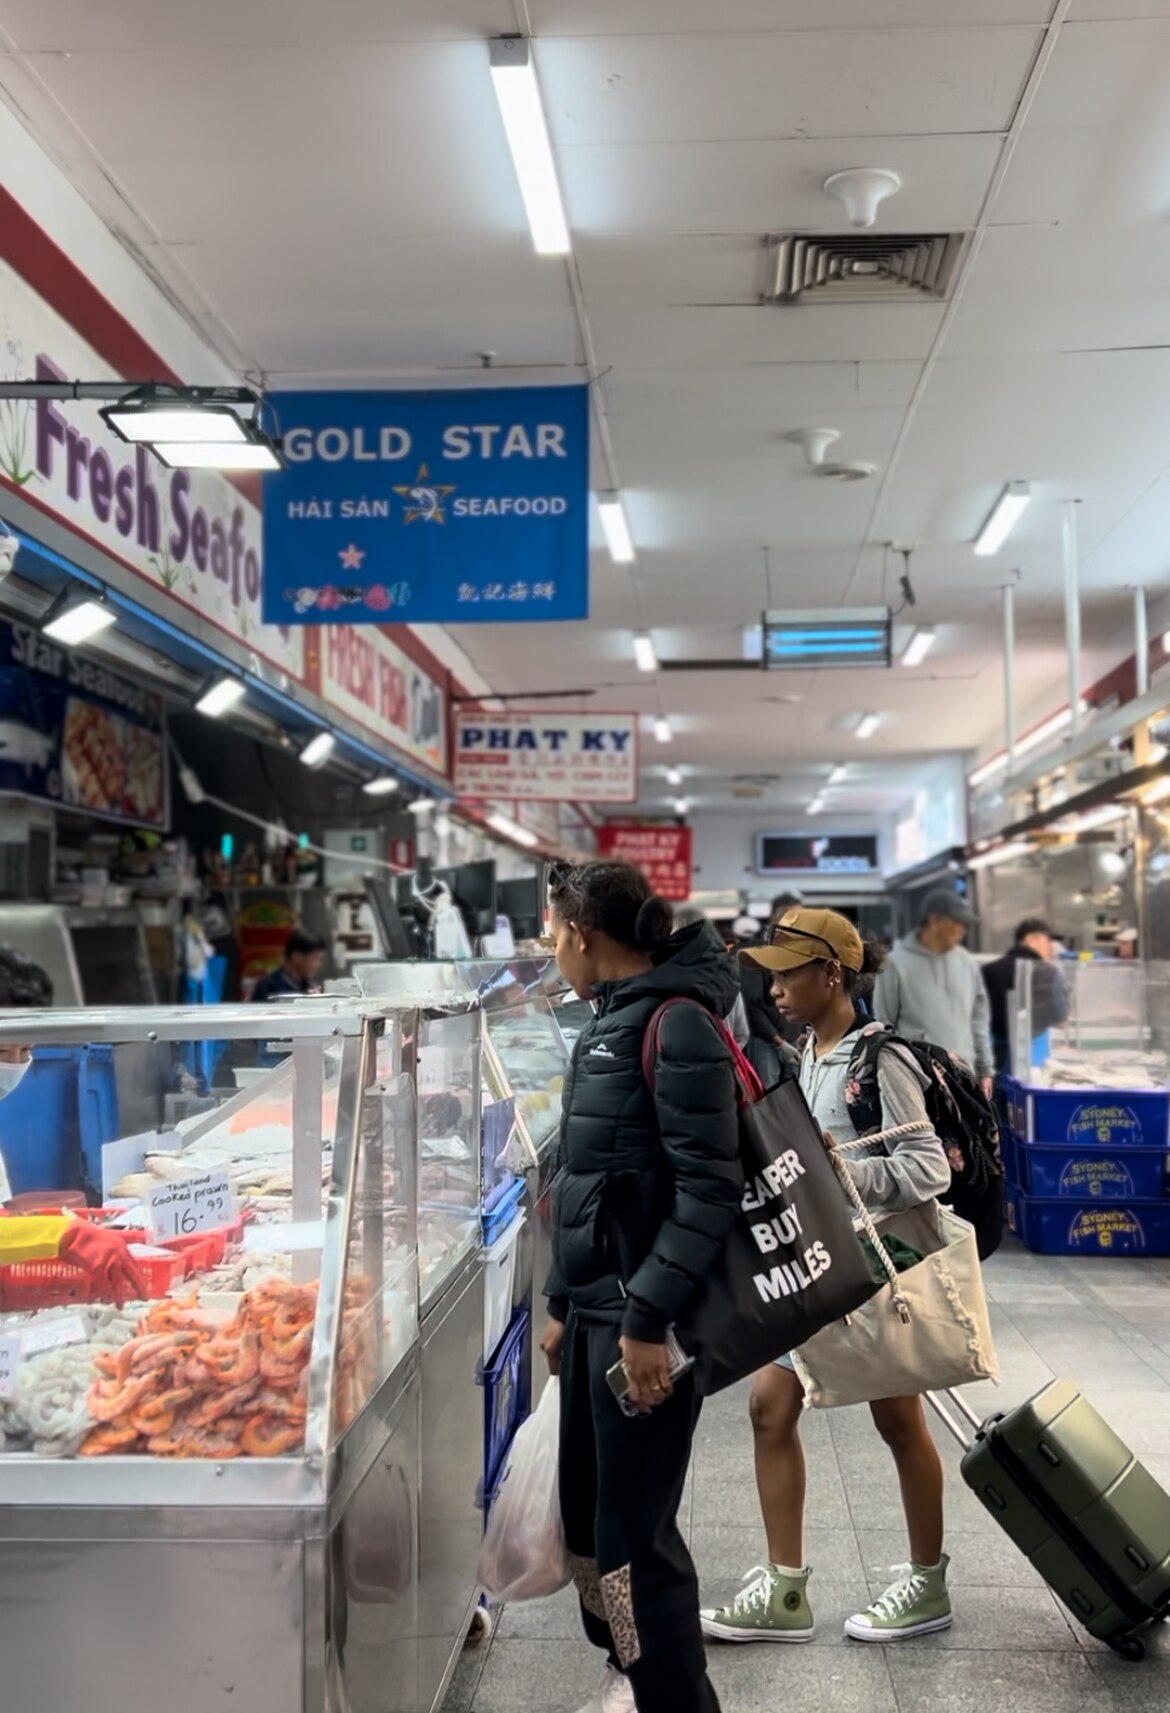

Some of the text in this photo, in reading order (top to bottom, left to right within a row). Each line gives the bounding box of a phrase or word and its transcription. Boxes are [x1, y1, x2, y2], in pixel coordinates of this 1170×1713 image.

[283, 424, 567, 462] GOLD STAR
[35, 352, 161, 554] Fresh
[453, 497, 567, 516] SEAFOOD
[11, 622, 63, 677] Star
[461, 729, 631, 750] PHAT KY
[1081, 1109, 1124, 1120] SYDNEY
[1071, 1119, 1137, 1132] FISH MARKET
[1072, 1163, 1116, 1175] SYDNEY
[166, 1175, 211, 1191] Thailand
[1063, 1173, 1128, 1186] FISH MARKET
[194, 1183, 229, 1204] prawn
[1081, 1212, 1125, 1225] SYDNEY
[751, 1203, 803, 1254] BUY
[1073, 1223, 1138, 1238] FISH MARKET
[752, 1240, 832, 1303] MILES
